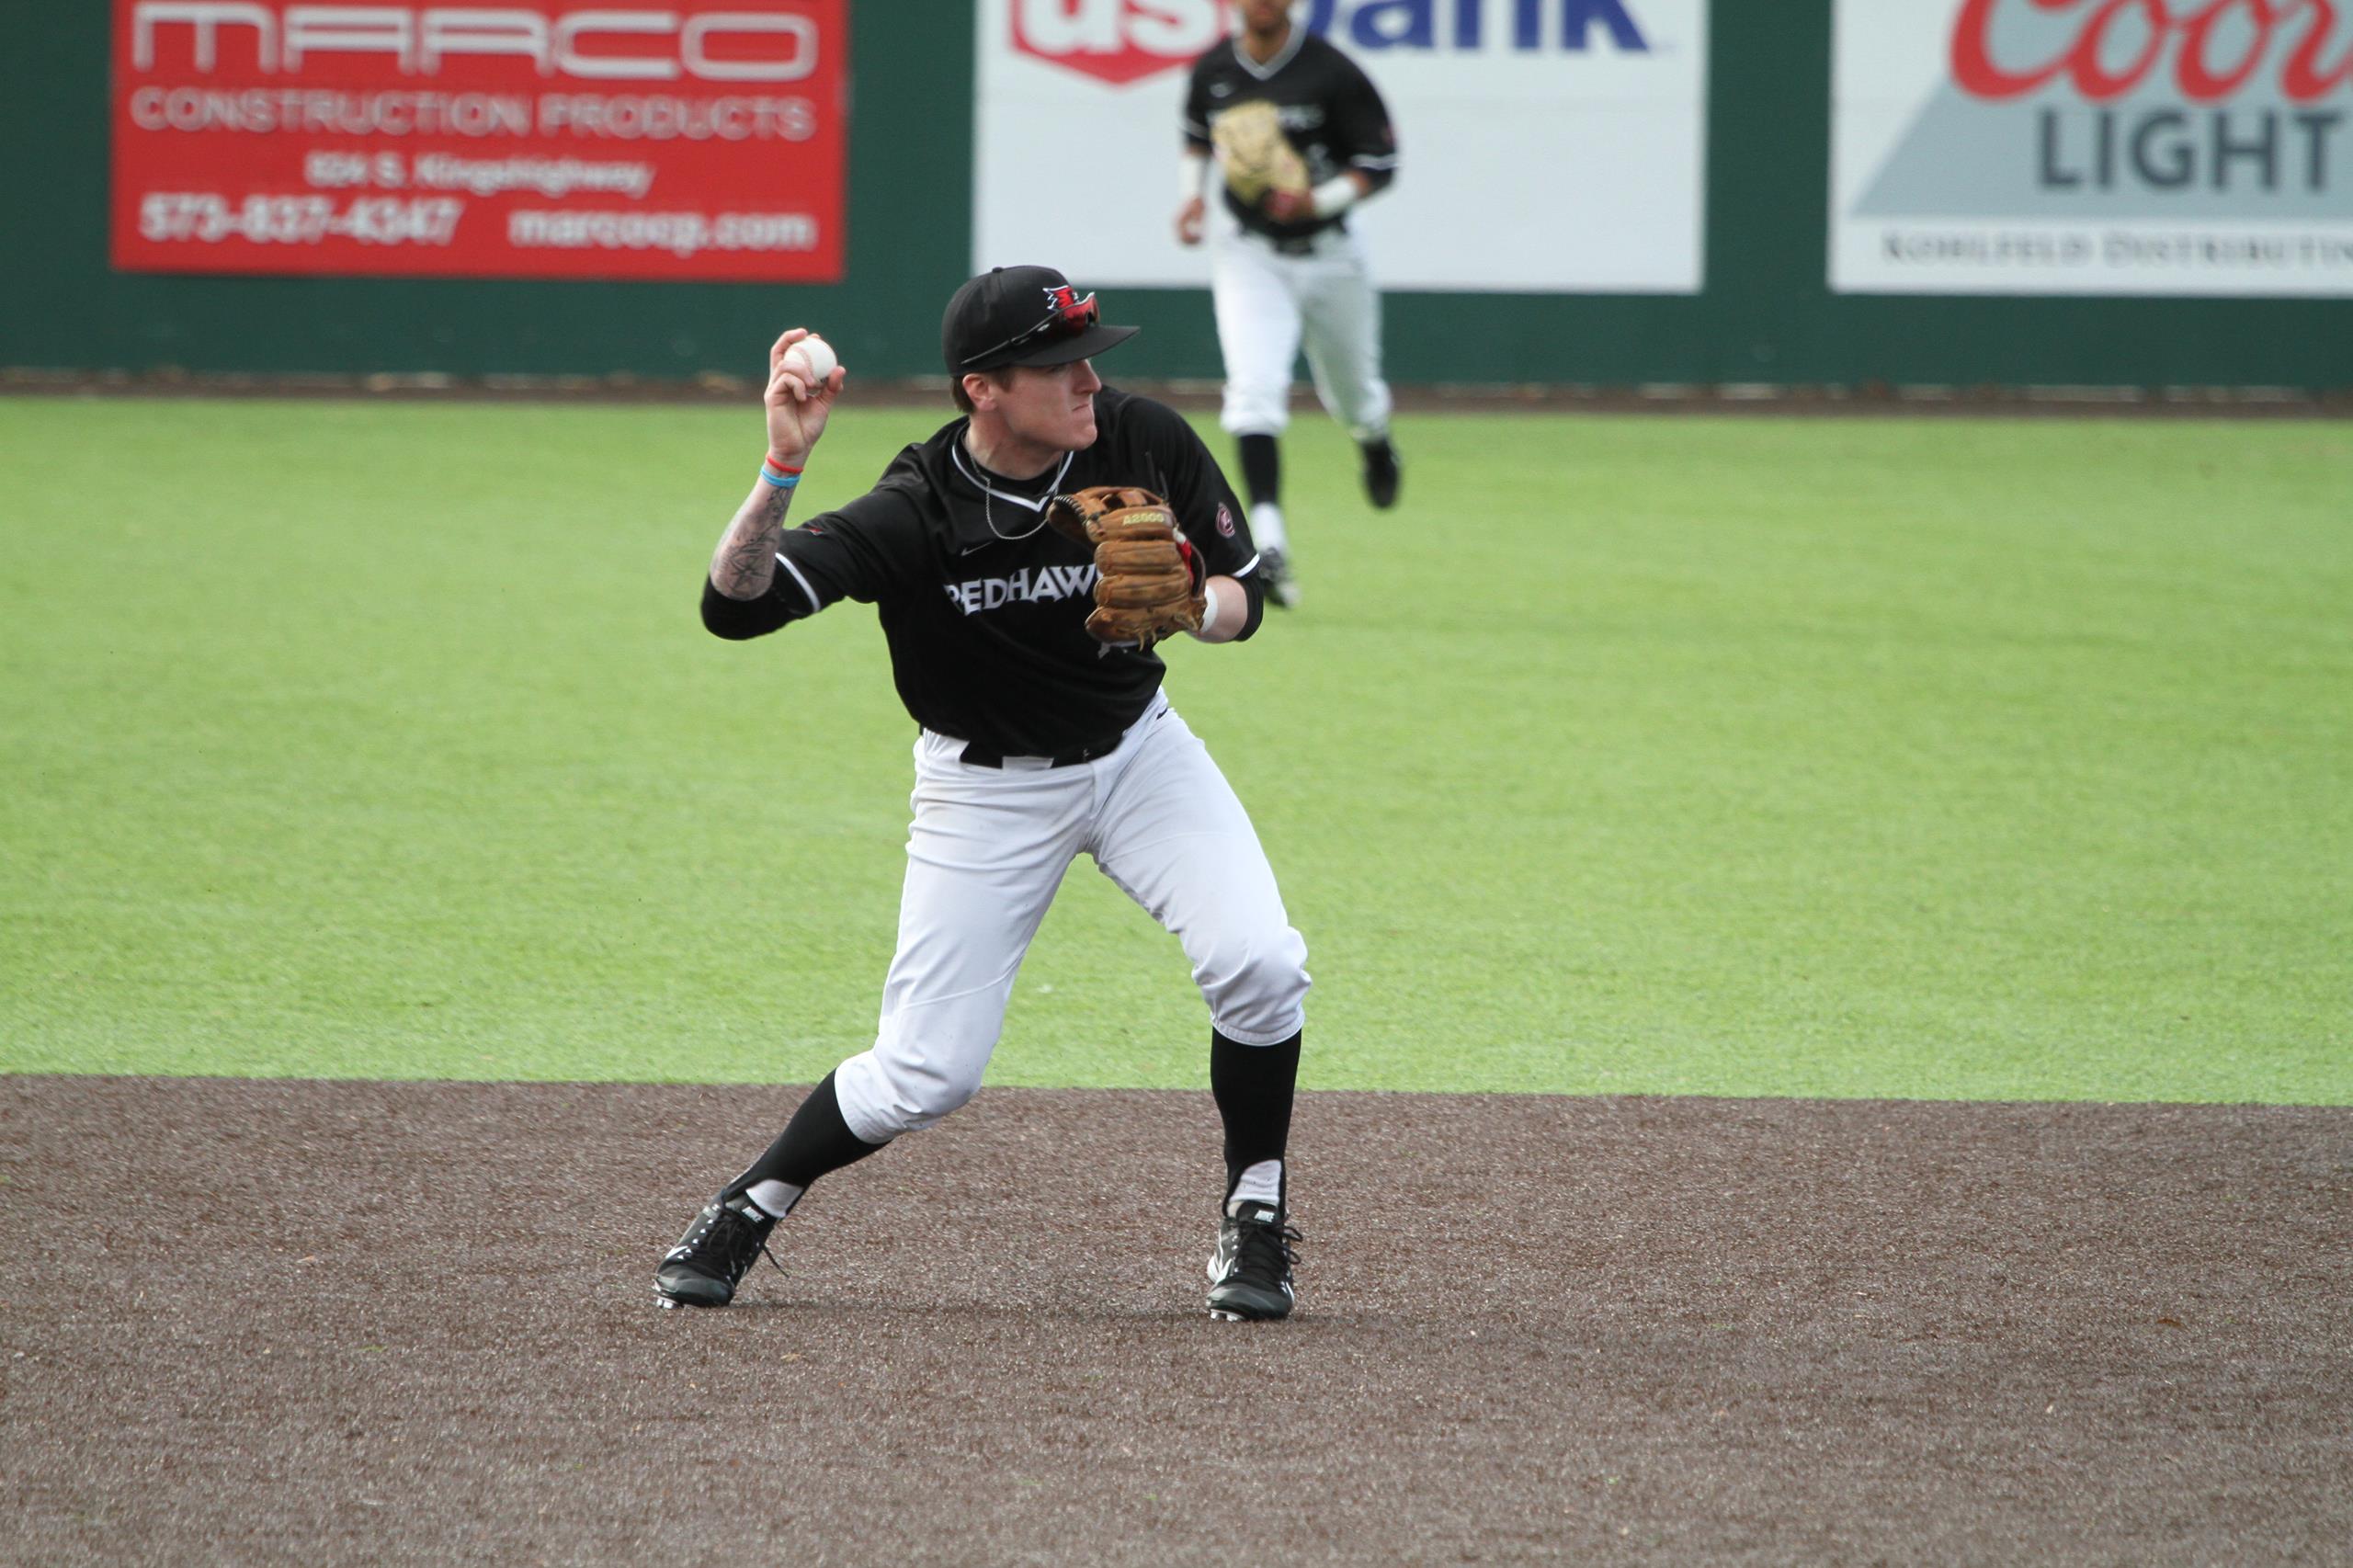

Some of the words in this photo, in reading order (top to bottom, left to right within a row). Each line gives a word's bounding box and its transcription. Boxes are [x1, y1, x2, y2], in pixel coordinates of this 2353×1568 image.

[133, 3, 818, 80] MARCO
[131, 87, 532, 137] CONSTRUCTION
[538, 93, 817, 141] PRODUCTS
[414, 153, 654, 199] Kingshighway
[2037, 107, 2344, 190] LIGHT
[142, 193, 464, 245] 573-837-4347
[508, 210, 817, 258] marcocp.com
